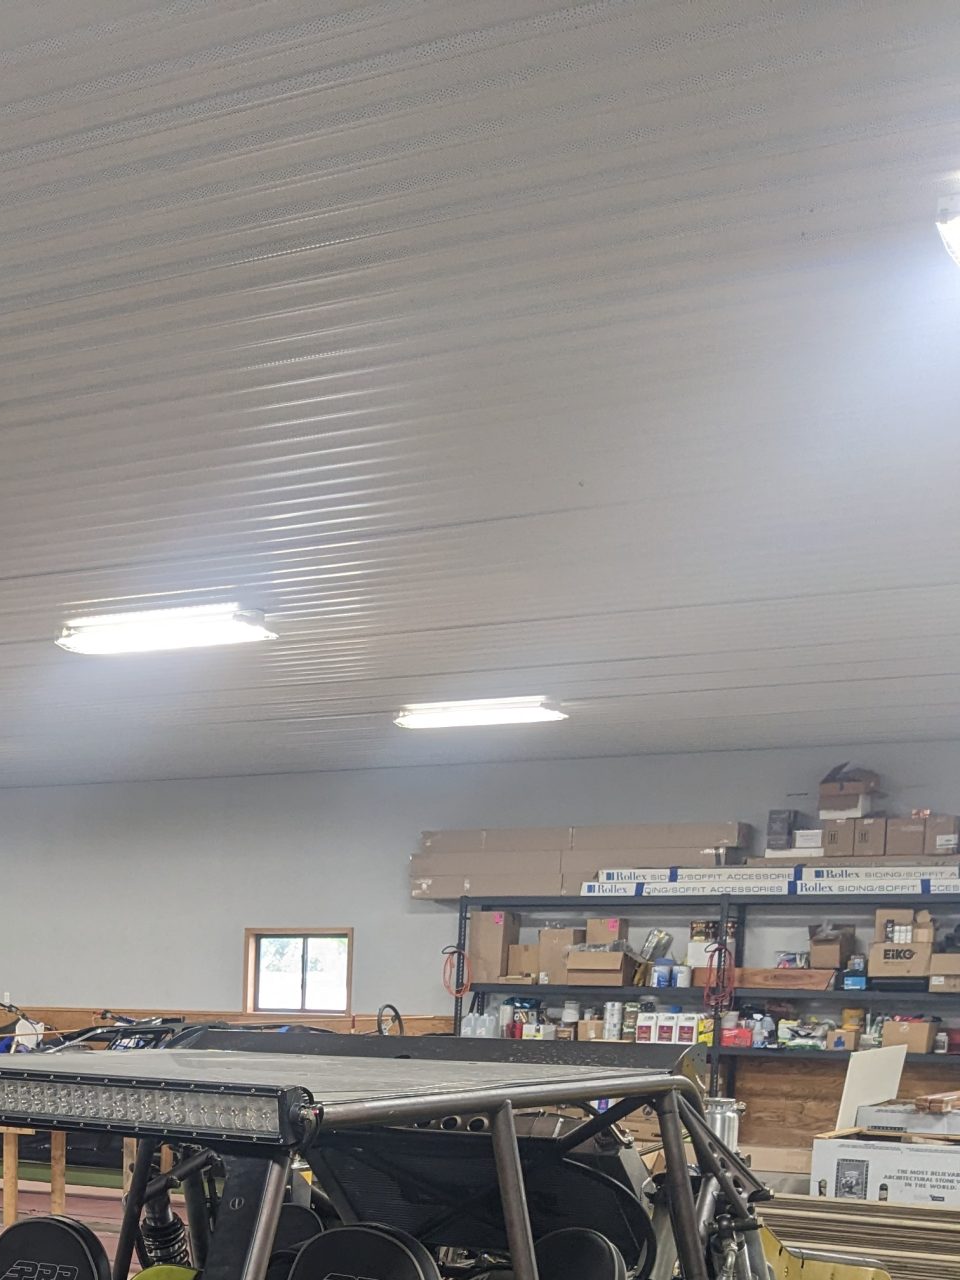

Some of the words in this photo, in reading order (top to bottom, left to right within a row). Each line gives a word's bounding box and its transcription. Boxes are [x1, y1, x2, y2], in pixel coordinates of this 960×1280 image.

[616, 871, 648, 881] Rollex
[650, 873, 722, 881] SIDG/SOFFIT
[826, 869, 860, 879] Rollex
[597, 884, 628, 894] Rollex
[644, 885, 706, 894] DING/SOFFIT
[710, 885, 783, 893] ACCESSORIES
[800, 882, 834, 893] Rollex
